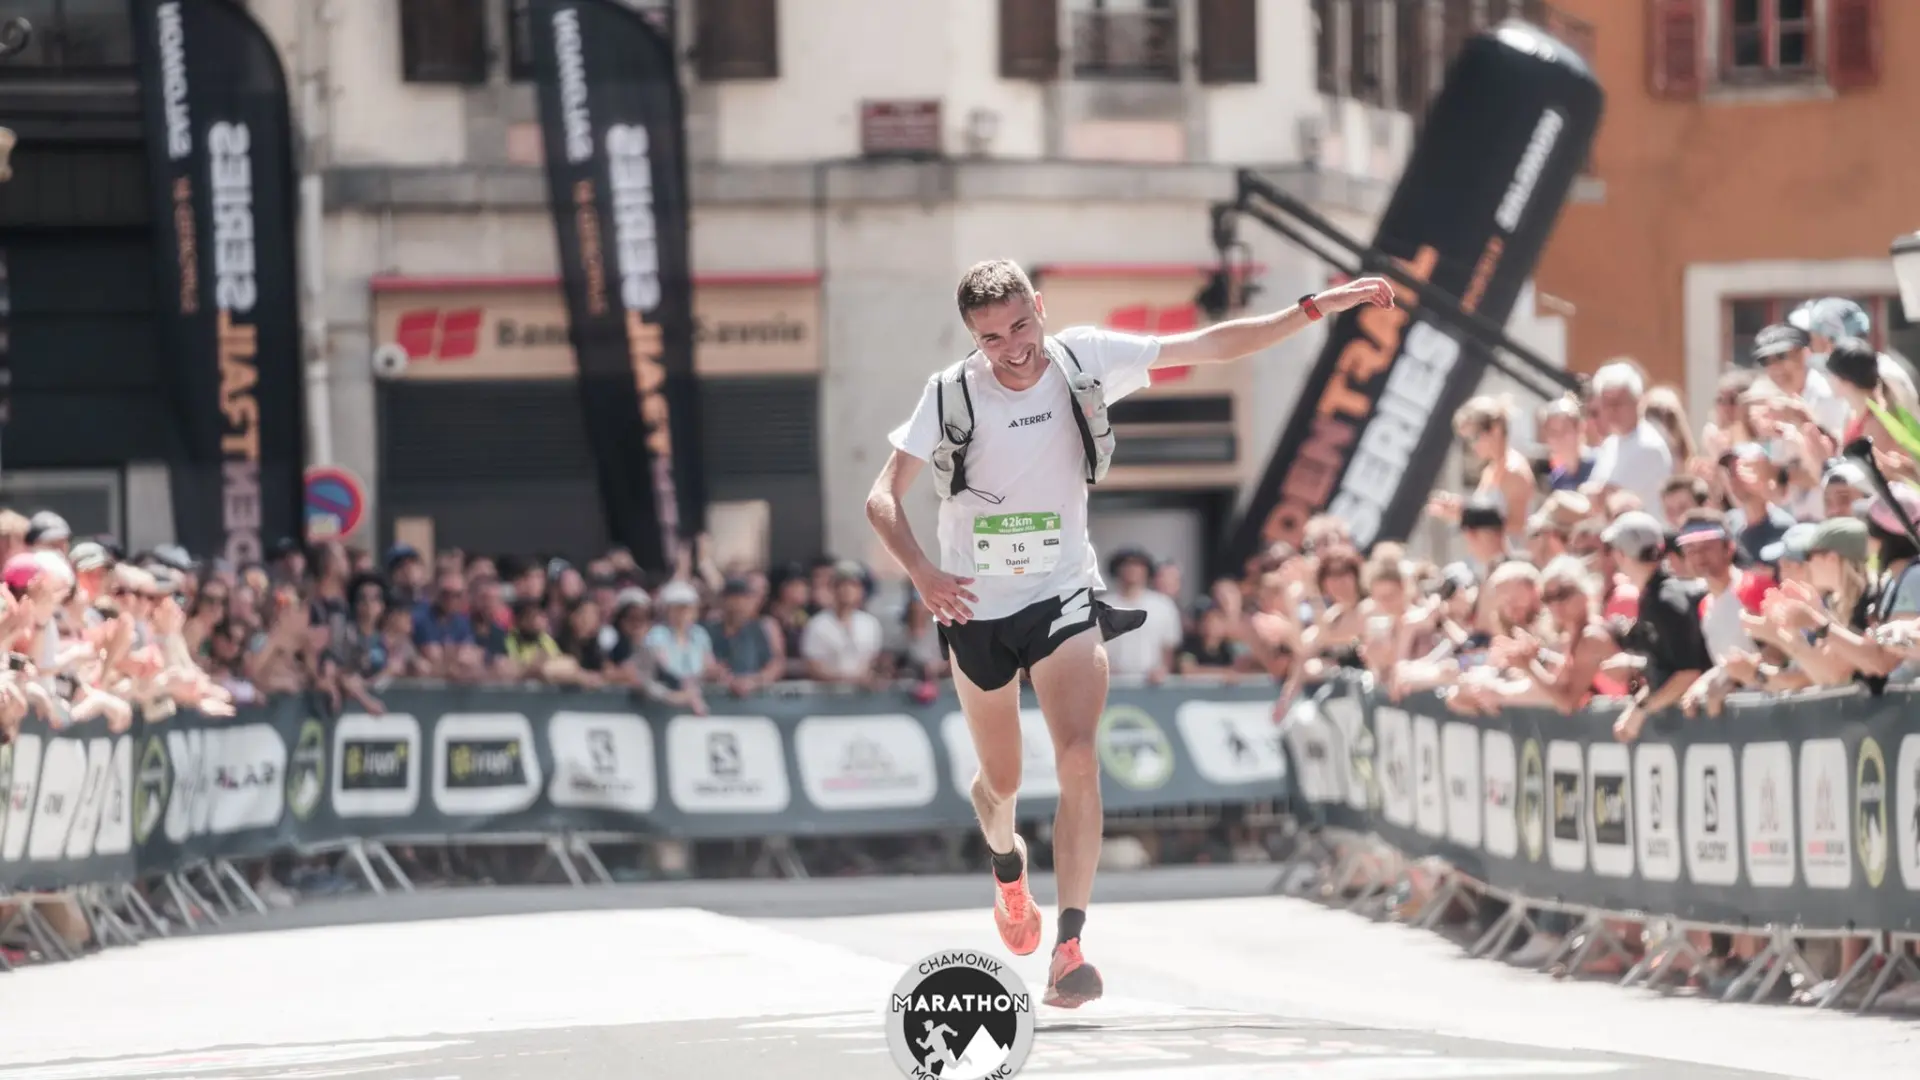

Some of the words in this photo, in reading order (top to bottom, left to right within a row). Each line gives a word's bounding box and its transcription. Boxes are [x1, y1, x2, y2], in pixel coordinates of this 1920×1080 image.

[495, 317, 570, 349] Ban
[1019, 411, 1052, 427] TERREX
[1326, 319, 1461, 552] SERIES
[1001, 516, 1033, 529] 42km
[1011, 541, 1026, 553] 16
[1005, 557, 1030, 567] Daniel
